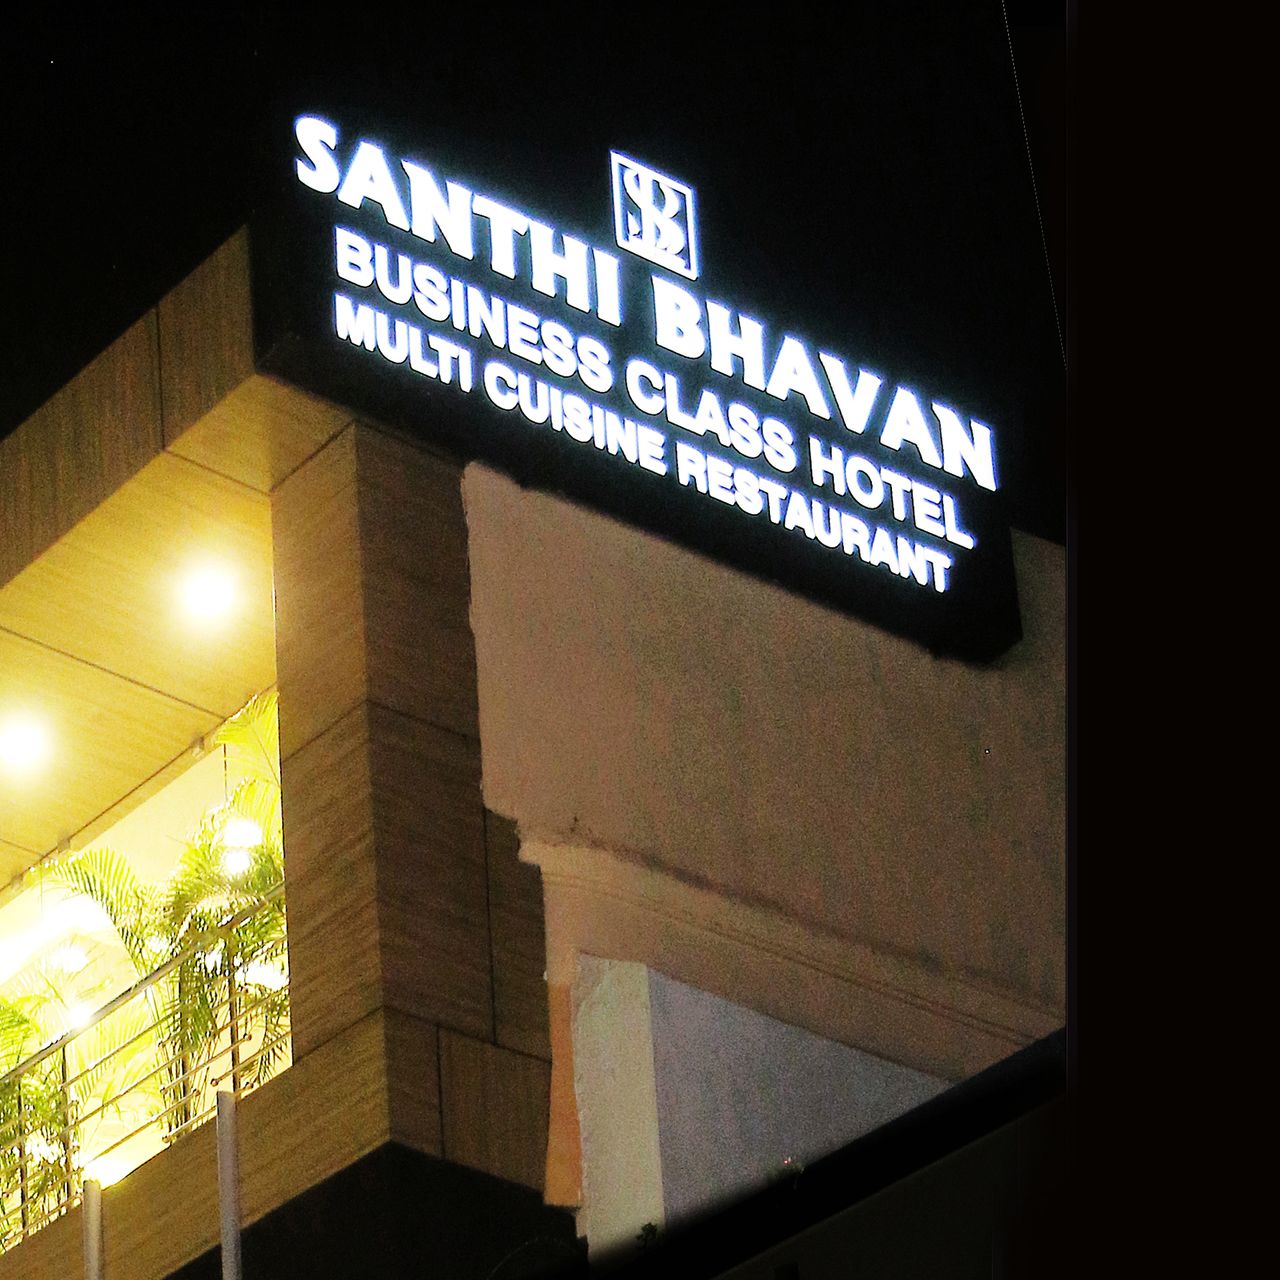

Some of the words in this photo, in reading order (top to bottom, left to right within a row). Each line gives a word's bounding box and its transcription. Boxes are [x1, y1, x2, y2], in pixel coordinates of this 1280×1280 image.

[294, 113, 622, 325] SANTHI
[651, 274, 999, 491] BHAVAN
[333, 295, 474, 393] MULTI
[483, 360, 667, 475] CUISINE
[675, 441, 953, 594] RESTAURANT
[334, 226, 613, 394] BUSINESS
[625, 361, 798, 473] CLASS
[808, 436, 976, 549] HOTEL
